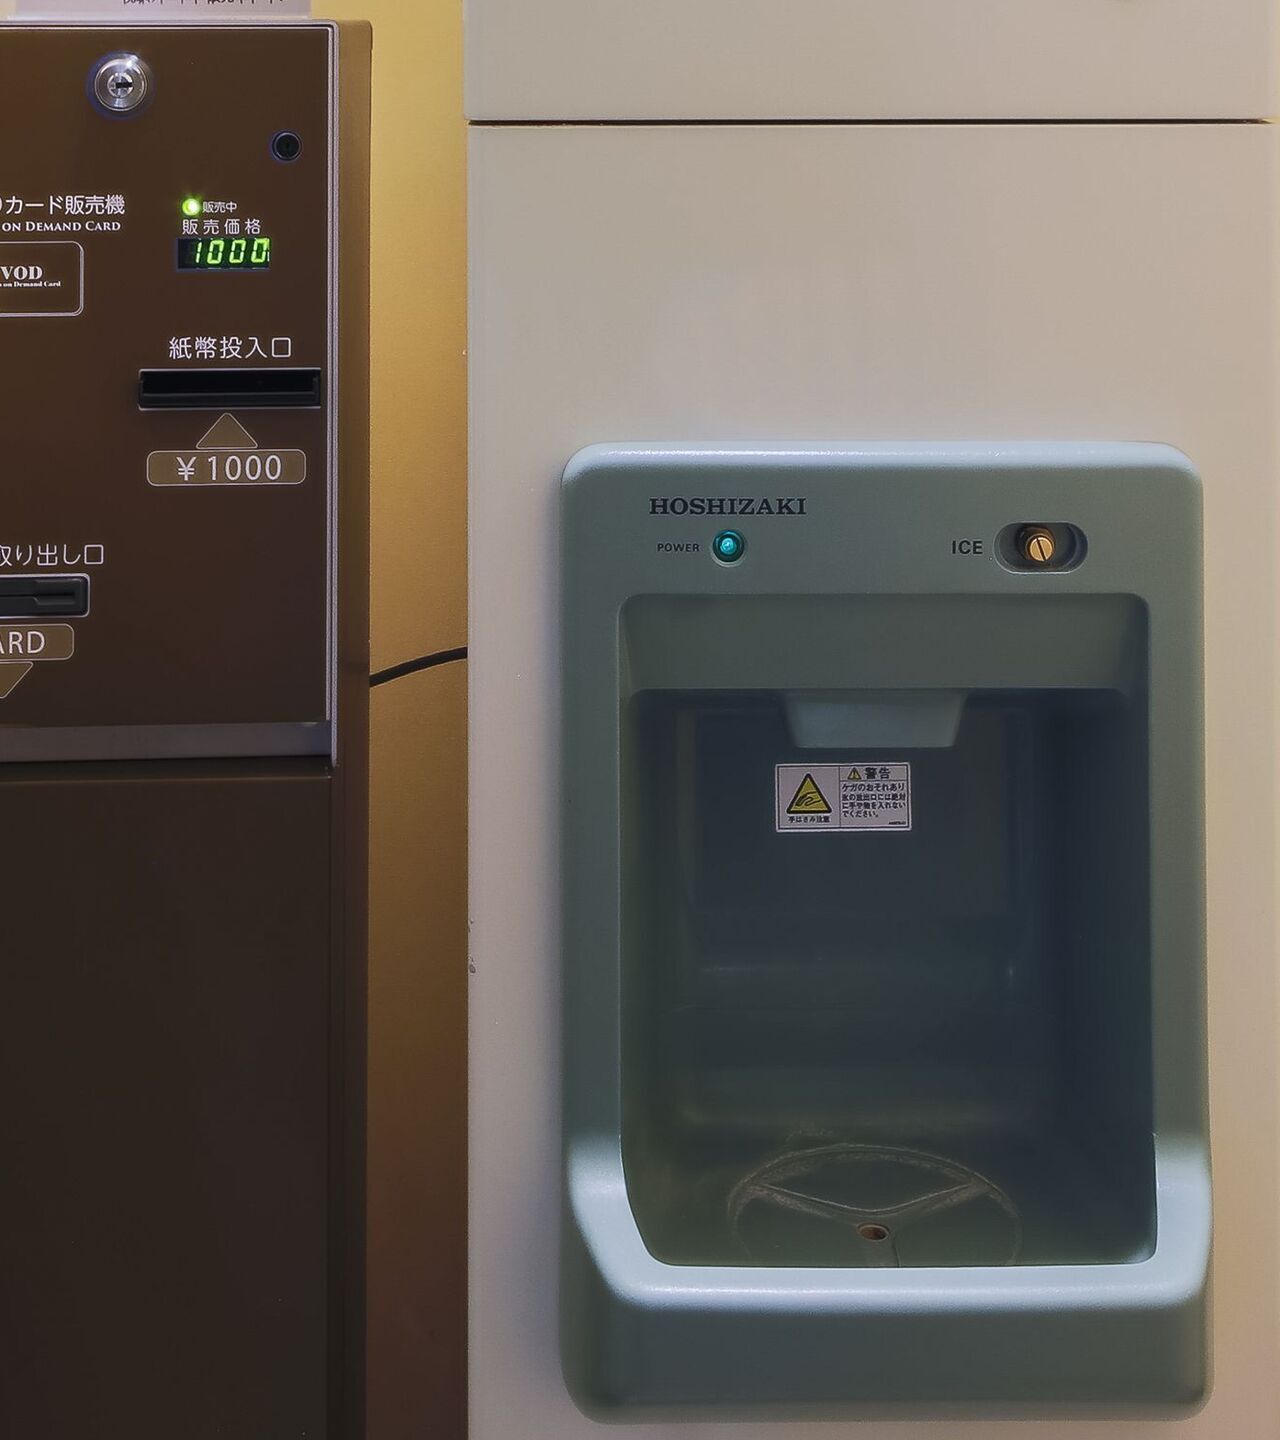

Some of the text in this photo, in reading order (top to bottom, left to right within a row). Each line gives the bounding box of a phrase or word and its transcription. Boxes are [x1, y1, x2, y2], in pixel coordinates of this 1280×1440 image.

[202, 201, 238, 213] 販売中
[182, 219, 261, 235] 販売価格
[195, 239, 269, 264] 1000
[0, 265, 43, 280] VOD
[14, 280, 43, 288] Demand
[44, 280, 61, 288] Card
[169, 336, 292, 359] 紙幣投入口
[648, 497, 807, 516] HOSHIZAKI
[656, 543, 700, 553] POWER
[951, 540, 983, 555] ICE
[864, 767, 891, 780] 警告
[841, 783, 905, 792] ケガのおそれあり
